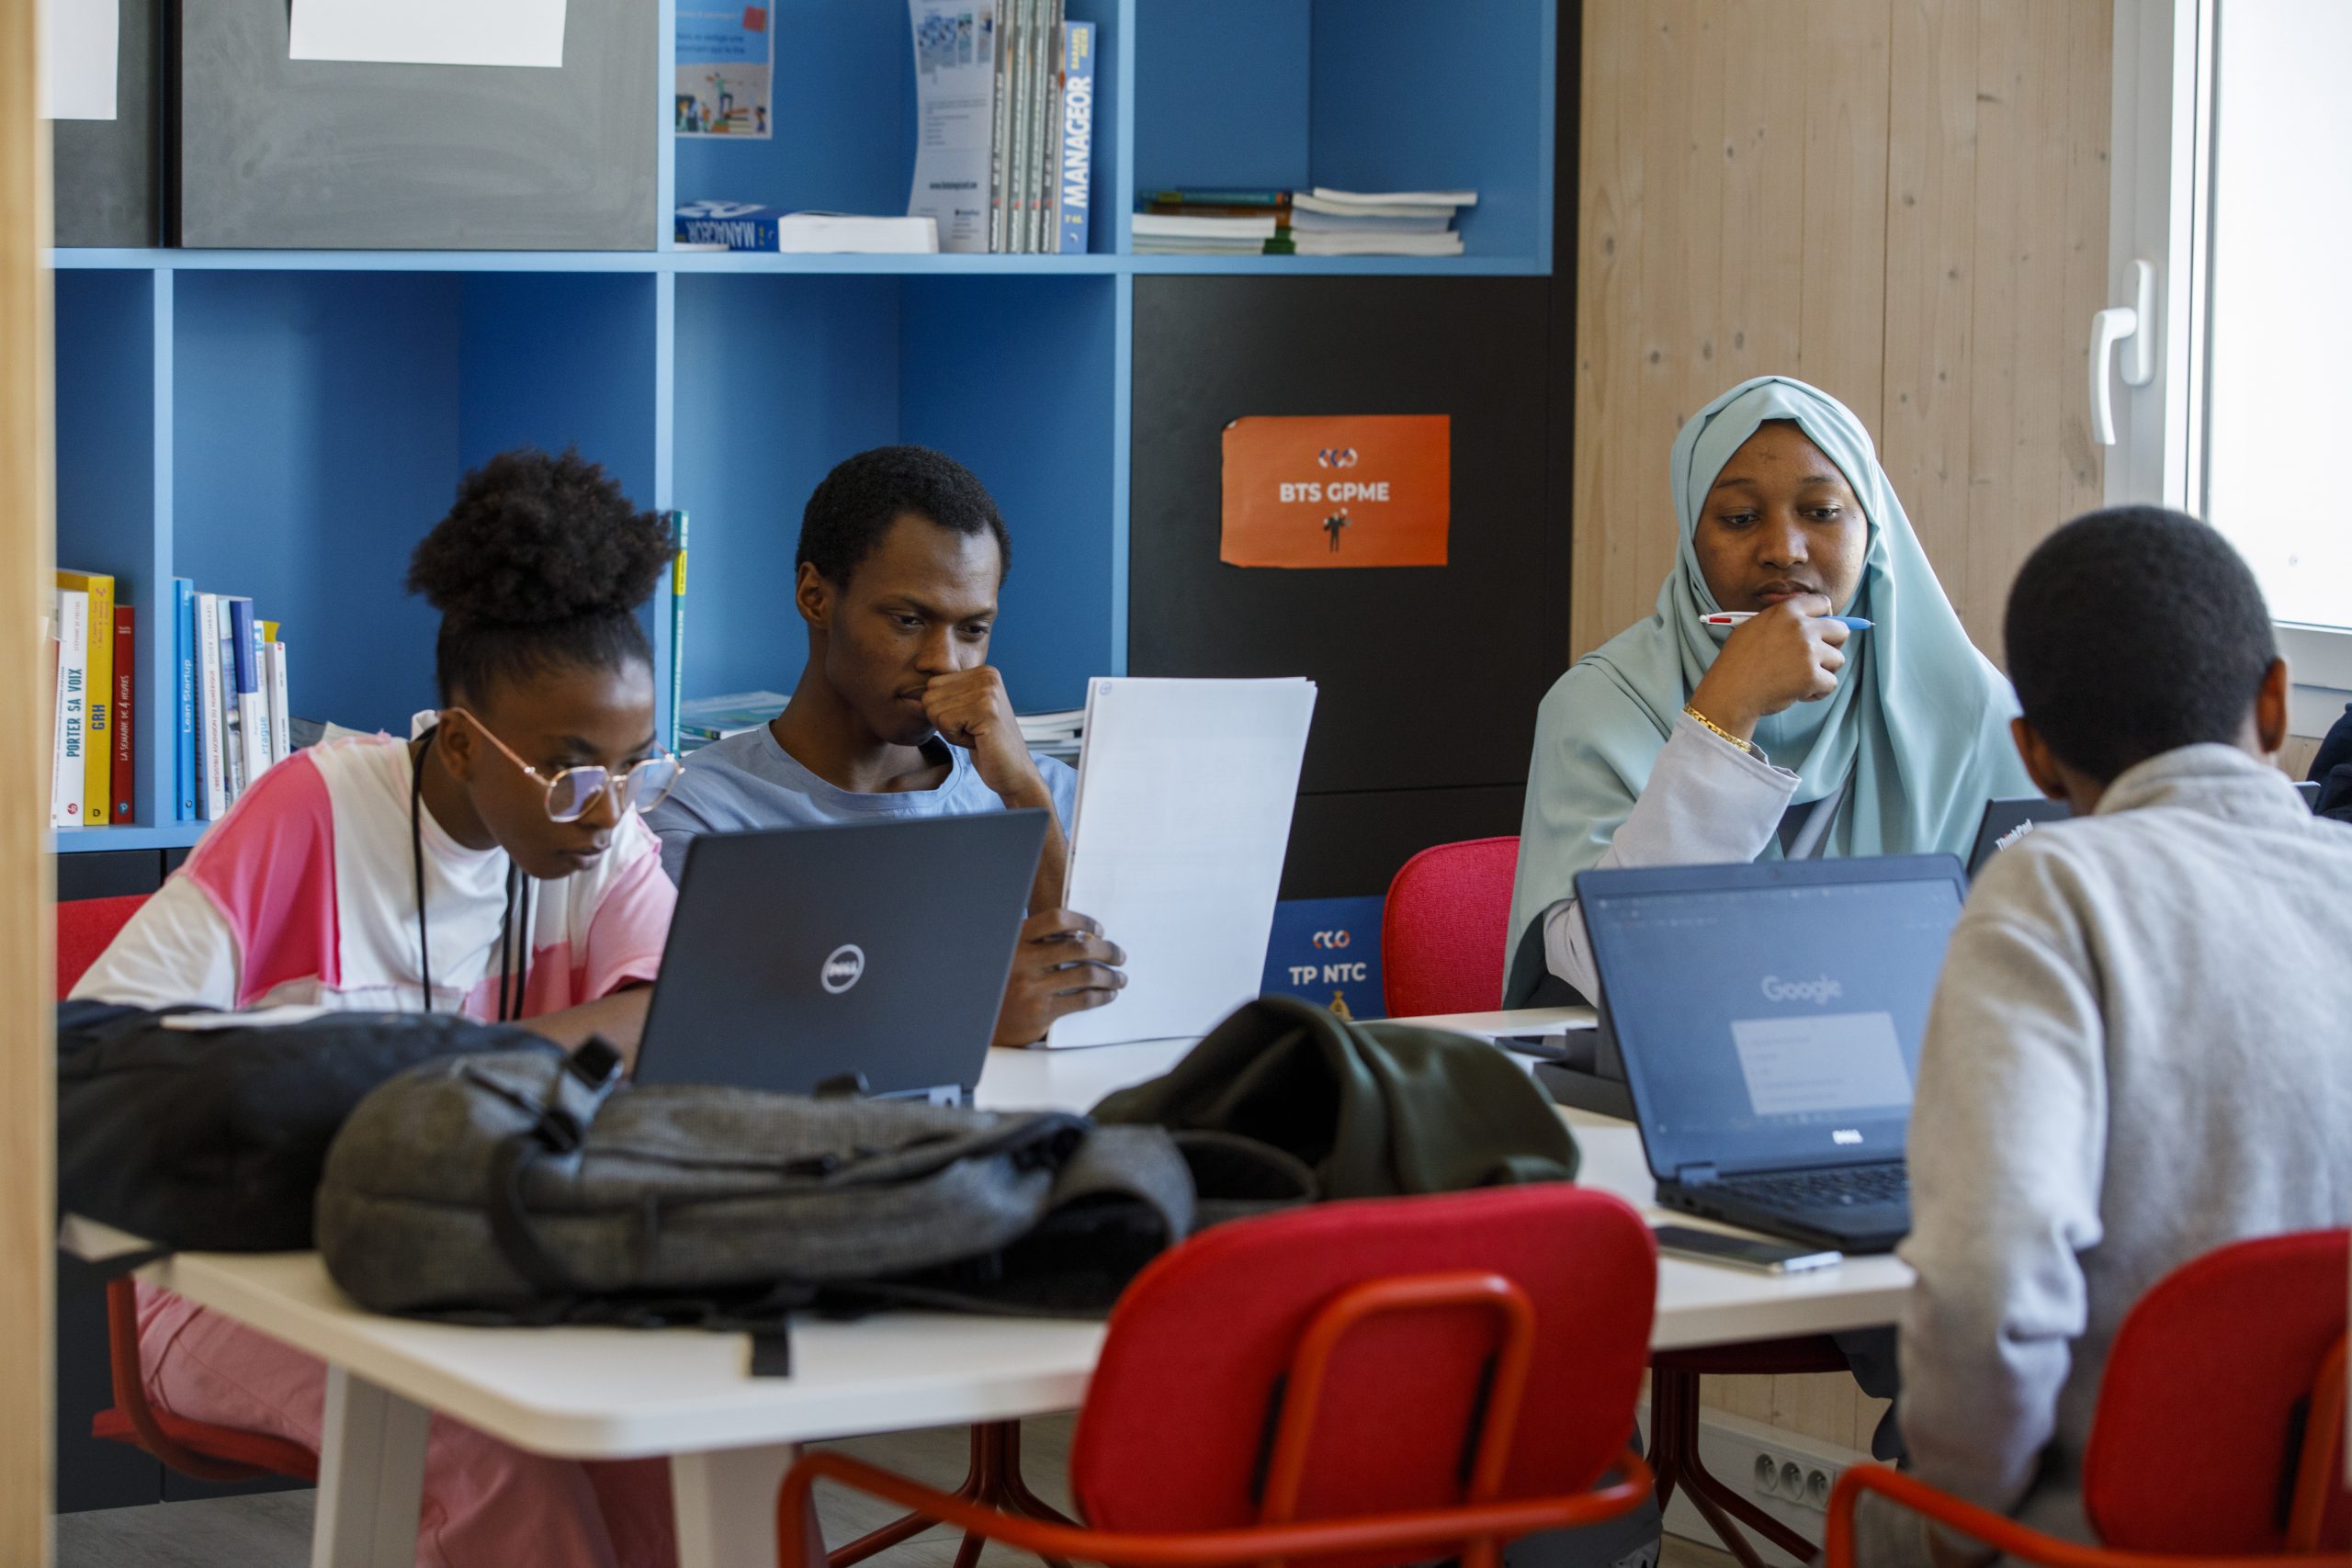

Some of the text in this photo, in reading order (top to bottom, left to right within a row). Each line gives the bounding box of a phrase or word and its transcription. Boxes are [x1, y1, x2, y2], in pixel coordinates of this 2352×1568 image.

[1063, 76, 1091, 208] MANAGEOR
[1279, 481, 1389, 503] BTS GPME
[120, 675, 130, 700] HEURES
[182, 660, 192, 733] Lean Startup
[66, 668, 83, 757] PORTER SA VOIX
[92, 704, 106, 730] GRH
[120, 710, 129, 718] DE
[211, 709, 218, 718] DU
[120, 721, 129, 750] SEMAINE
[120, 751, 129, 761] LA
[1995, 818, 2034, 852] ThinkPad
[829, 960, 857, 977] DELL
[1289, 962, 1367, 986] TP NTC
[1761, 975, 1842, 1005] Google
[1832, 1129, 1864, 1145] DELL
